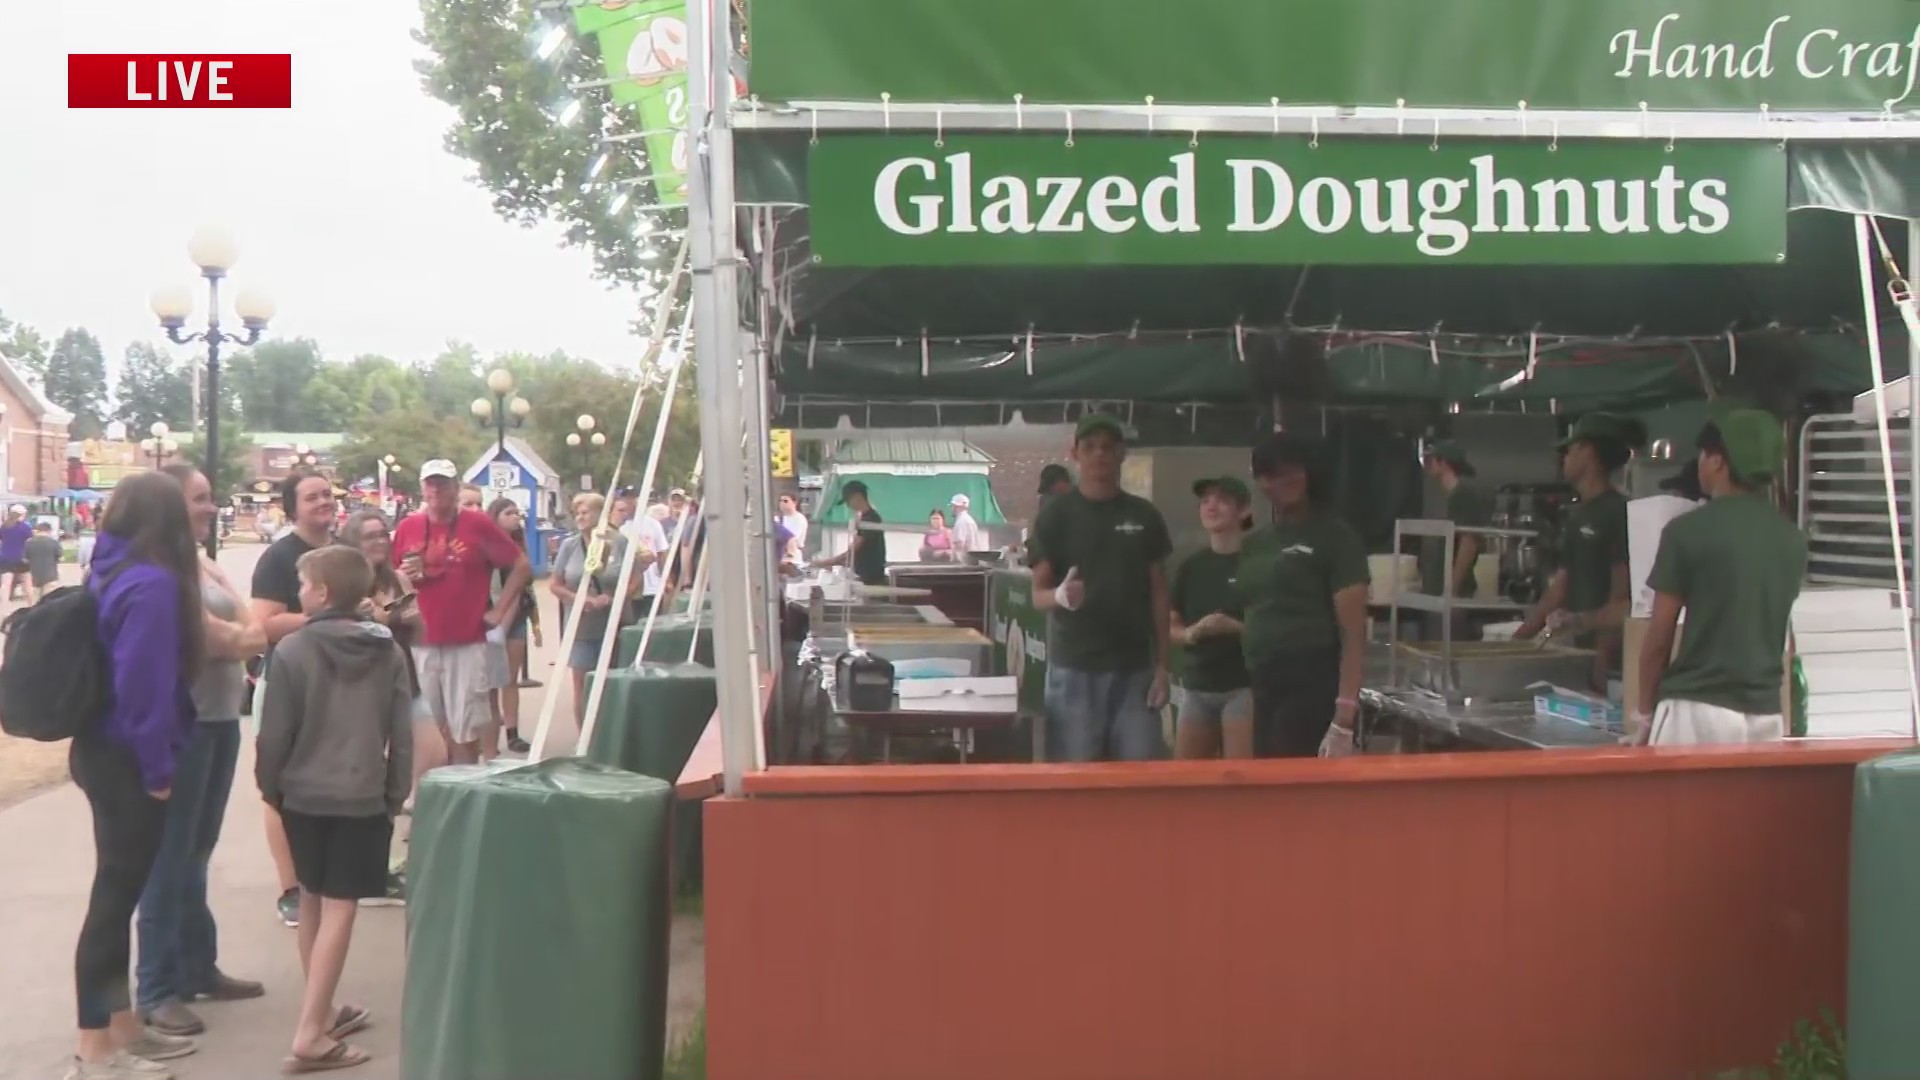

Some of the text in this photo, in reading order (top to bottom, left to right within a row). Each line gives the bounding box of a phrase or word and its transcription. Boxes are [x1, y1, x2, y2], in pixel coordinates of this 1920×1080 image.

[1609, 13, 1792, 80] Hand
[873, 154, 1731, 257] Glazed Doughnuts
